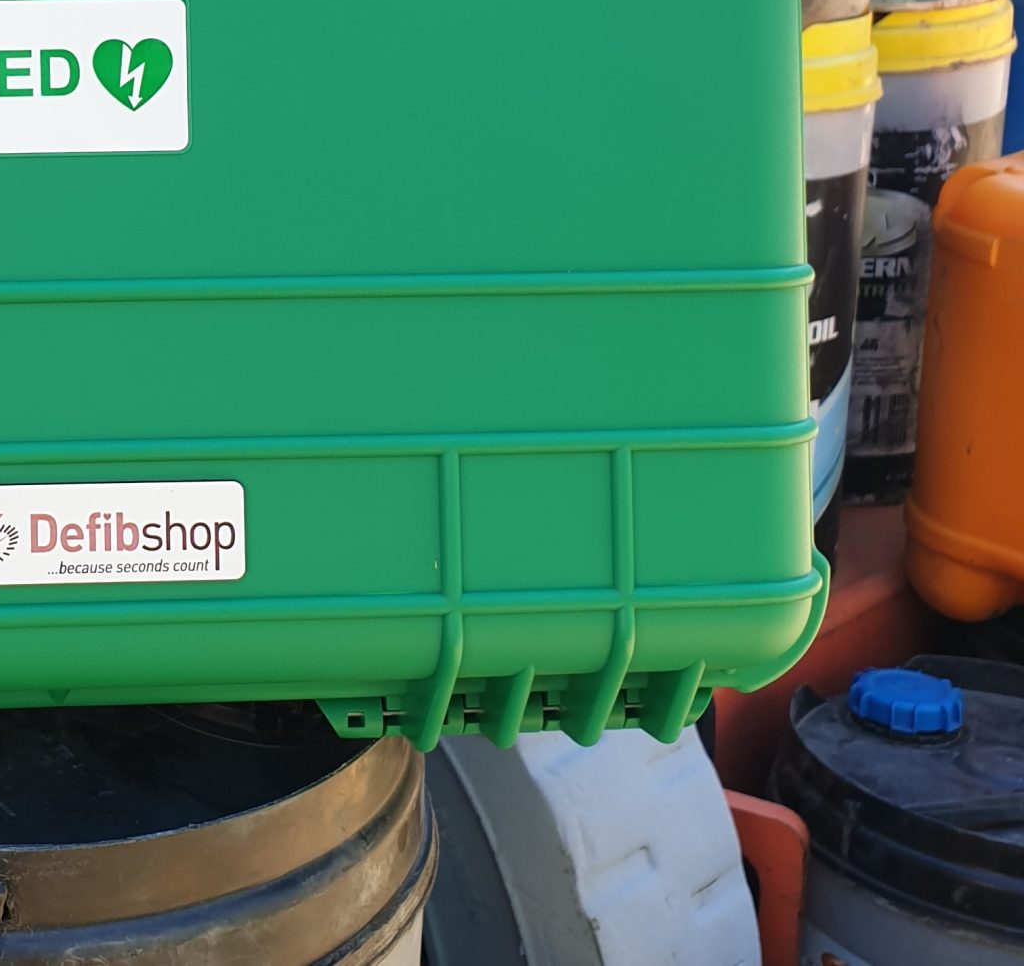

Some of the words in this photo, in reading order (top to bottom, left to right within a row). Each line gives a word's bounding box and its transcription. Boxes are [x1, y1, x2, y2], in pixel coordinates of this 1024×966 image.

[809, 315, 839, 346] OIL
[31, 511, 236, 571] Defibshop
[47, 560, 113, 575] ...because
[116, 559, 170, 574] seconds
[173, 559, 209, 572] count
